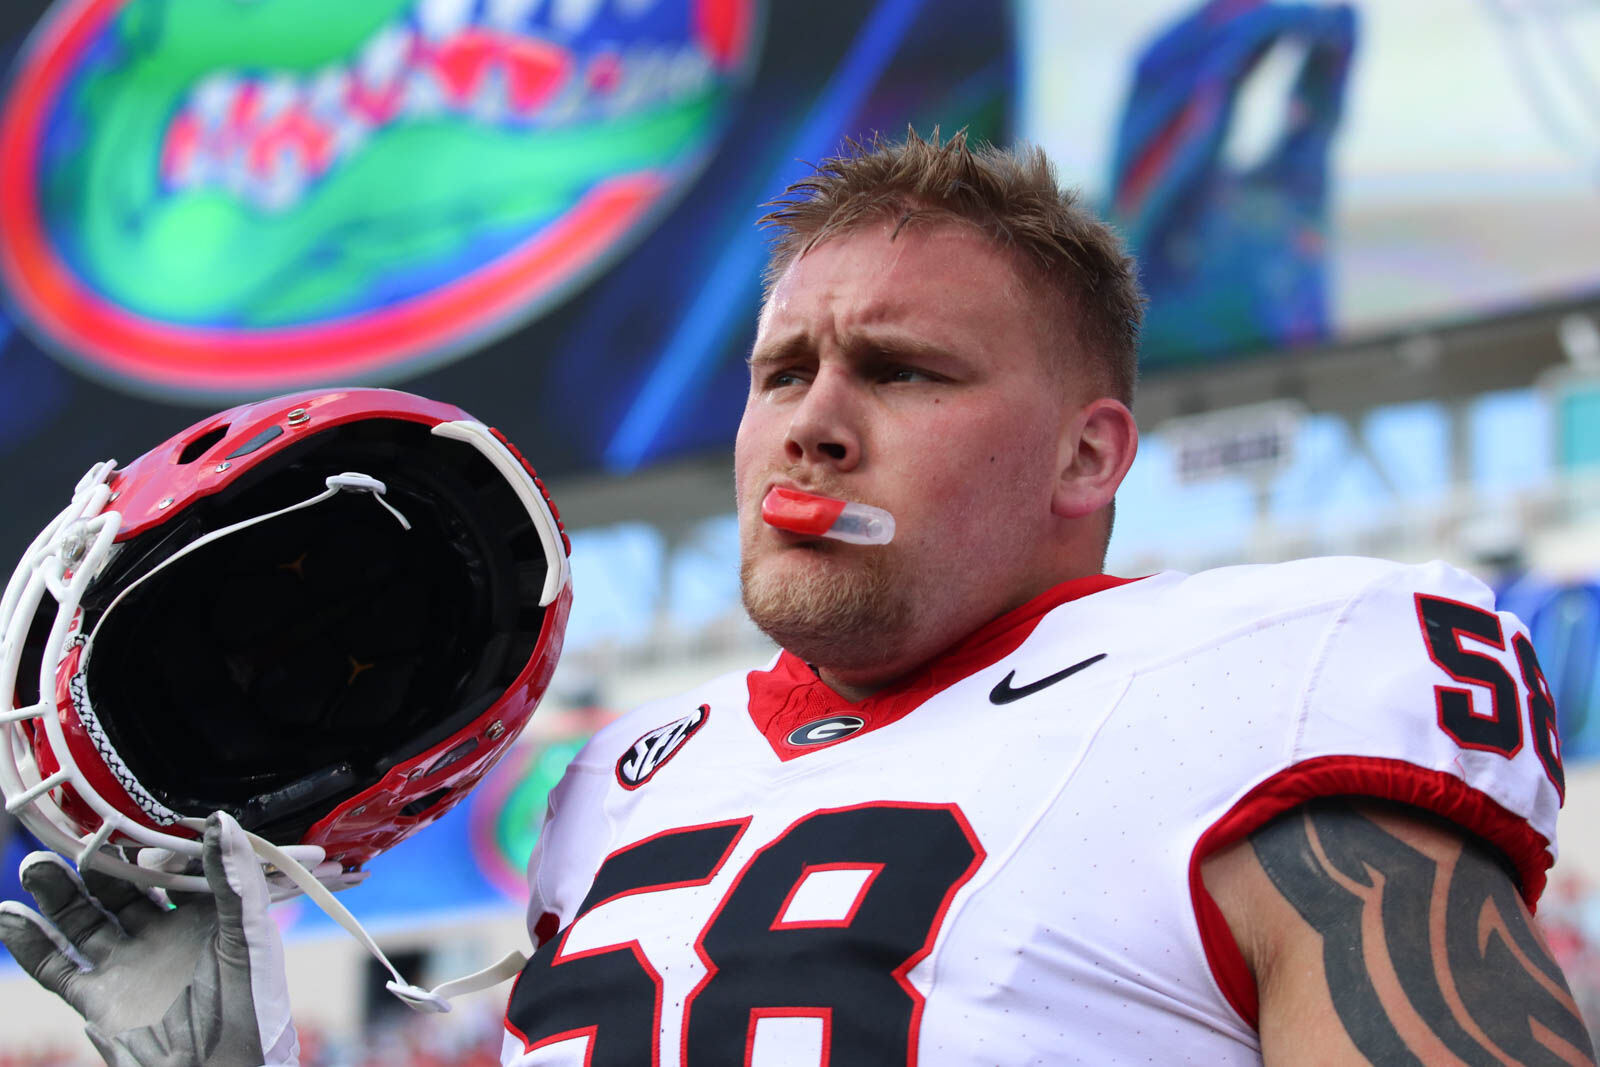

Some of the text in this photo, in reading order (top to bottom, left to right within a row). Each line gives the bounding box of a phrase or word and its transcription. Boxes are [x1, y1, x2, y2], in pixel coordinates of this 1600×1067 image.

[621, 708, 702, 782] SEC
[788, 716, 864, 745] G
[504, 800, 988, 1067] 58
